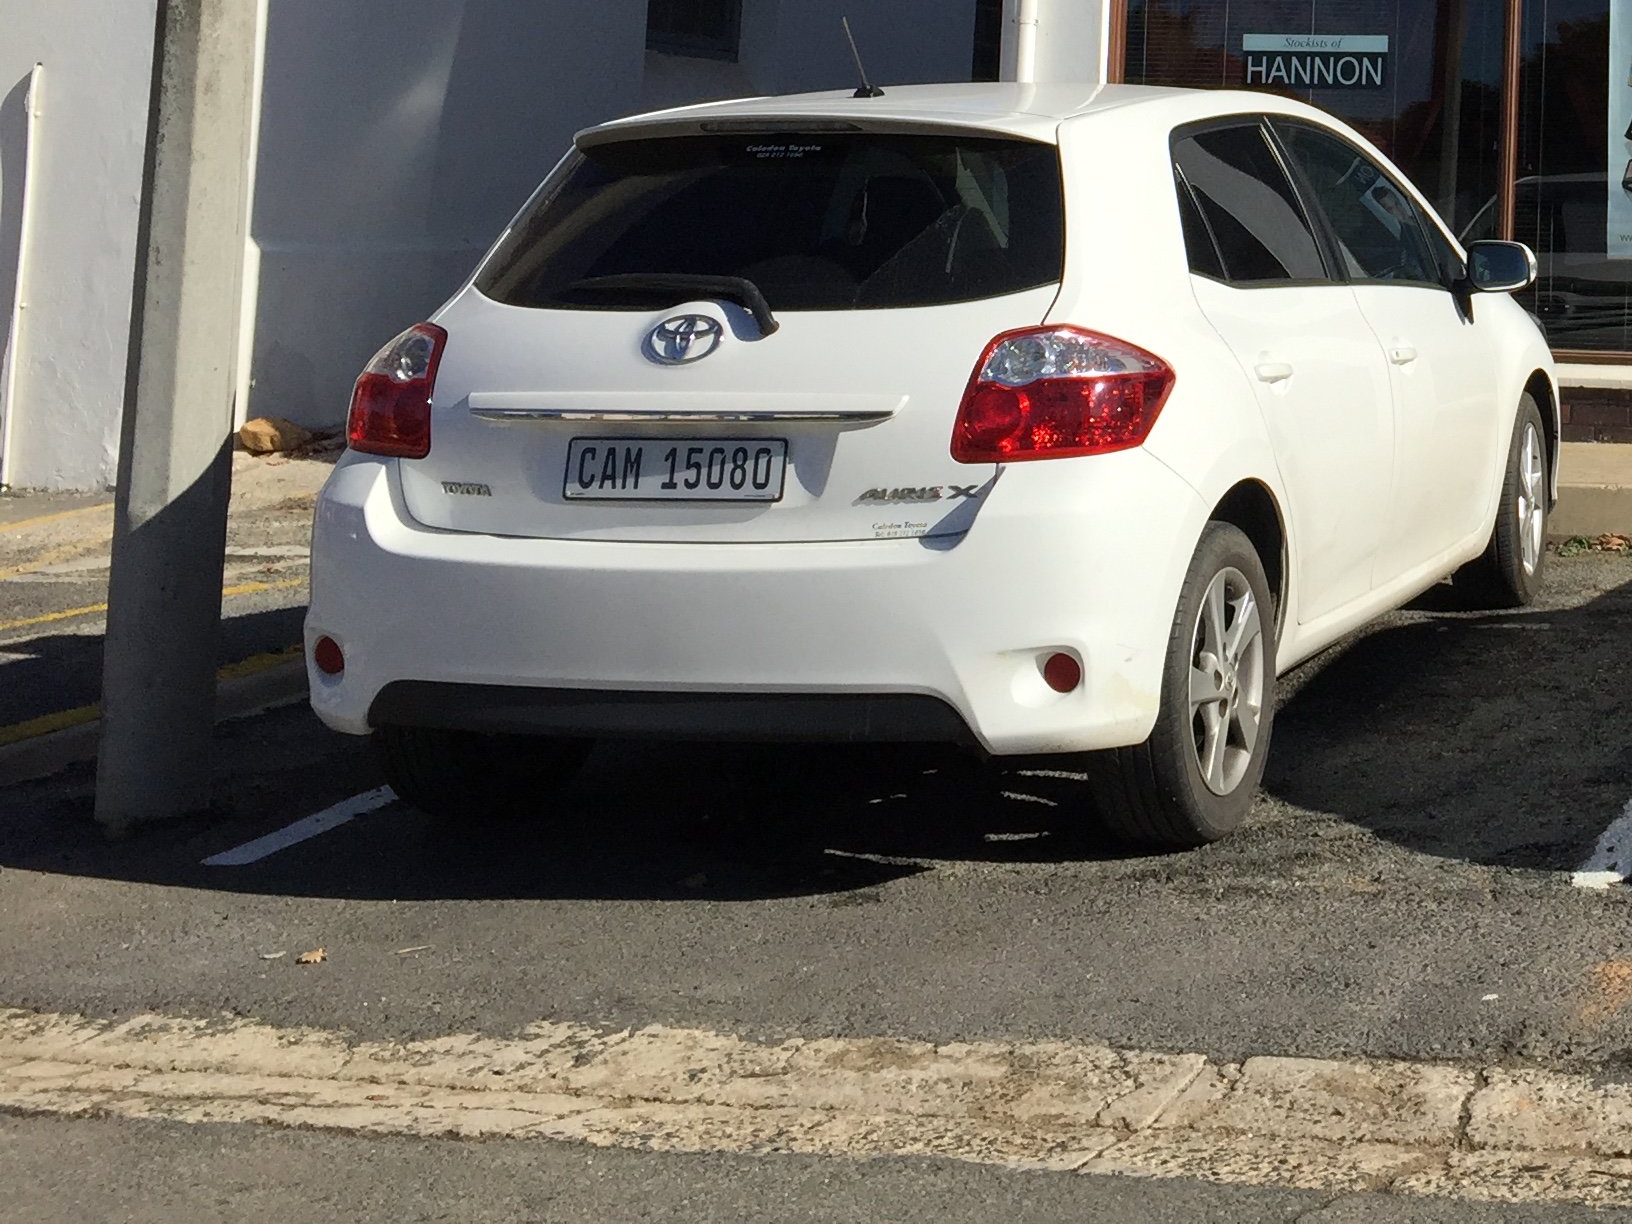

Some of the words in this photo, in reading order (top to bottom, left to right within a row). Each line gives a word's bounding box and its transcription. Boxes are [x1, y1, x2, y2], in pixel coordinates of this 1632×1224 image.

[1283, 37, 1328, 49] Stockists
[1330, 37, 1343, 49] of
[1246, 55, 1383, 86] HANNON
[577, 446, 644, 491] CAM
[660, 446, 773, 492] 15080
[441, 480, 493, 497] TOYOTA
[857, 485, 944, 501] AURIS
[945, 484, 979, 500] X
